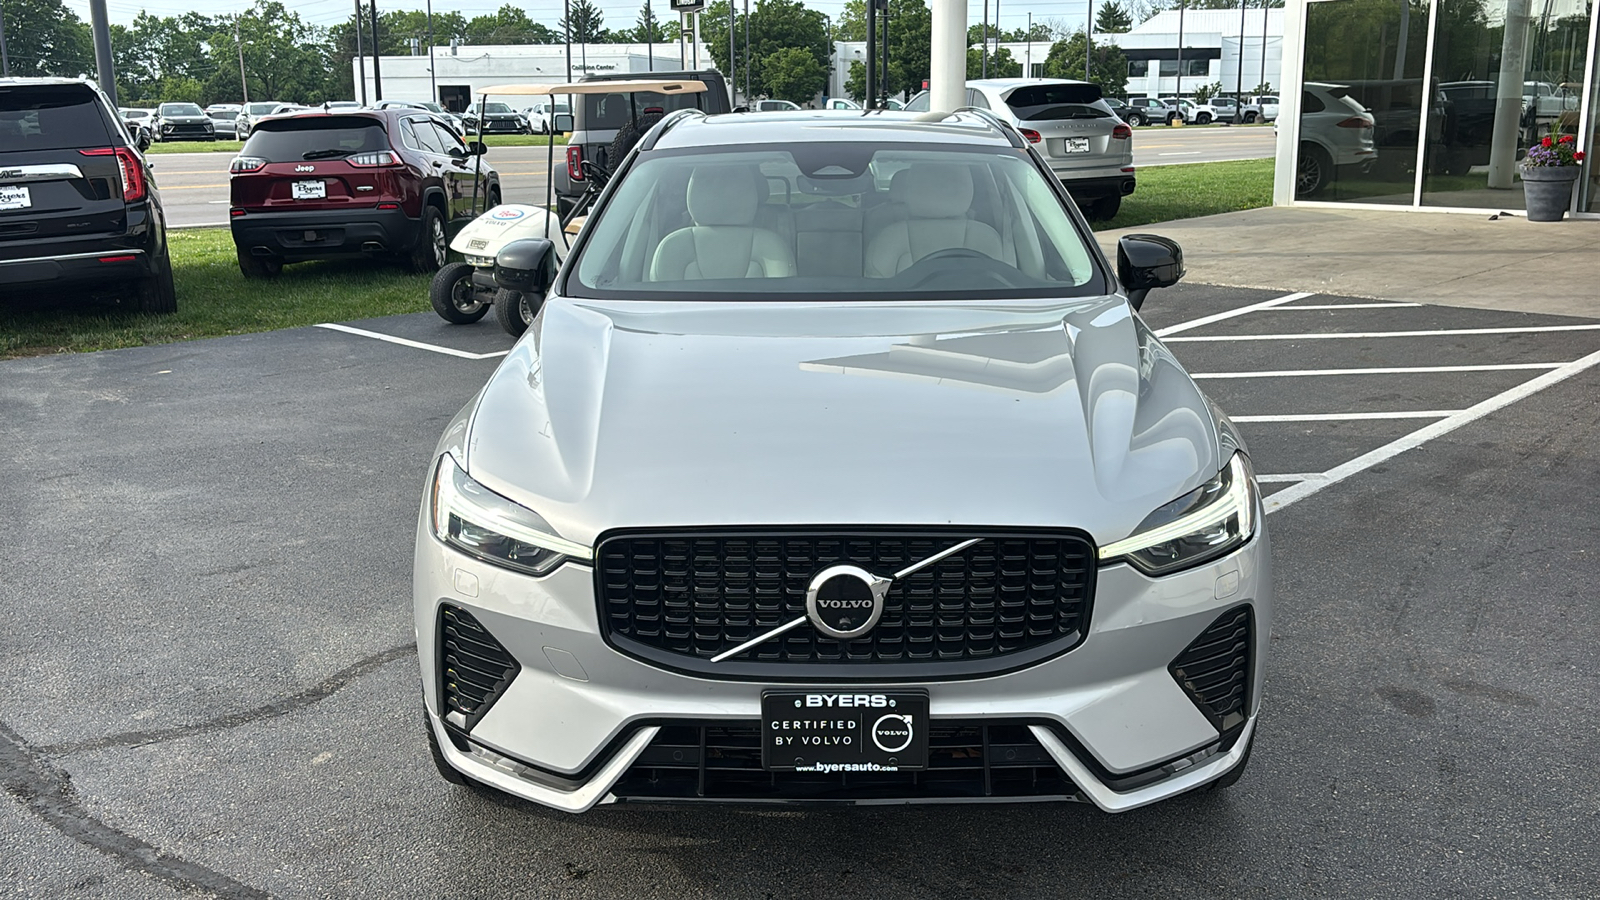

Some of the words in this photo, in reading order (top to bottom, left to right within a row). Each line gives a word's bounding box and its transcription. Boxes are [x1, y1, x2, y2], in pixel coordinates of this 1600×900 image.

[294, 164, 315, 173] Jeep
[817, 599, 873, 609] VOLVO
[805, 694, 888, 708] BYERS
[771, 720, 856, 730] CERTIFIED
[775, 736, 794, 745] BY
[801, 736, 852, 745] VOLVO
[795, 761, 898, 774] www.byersauto.com
